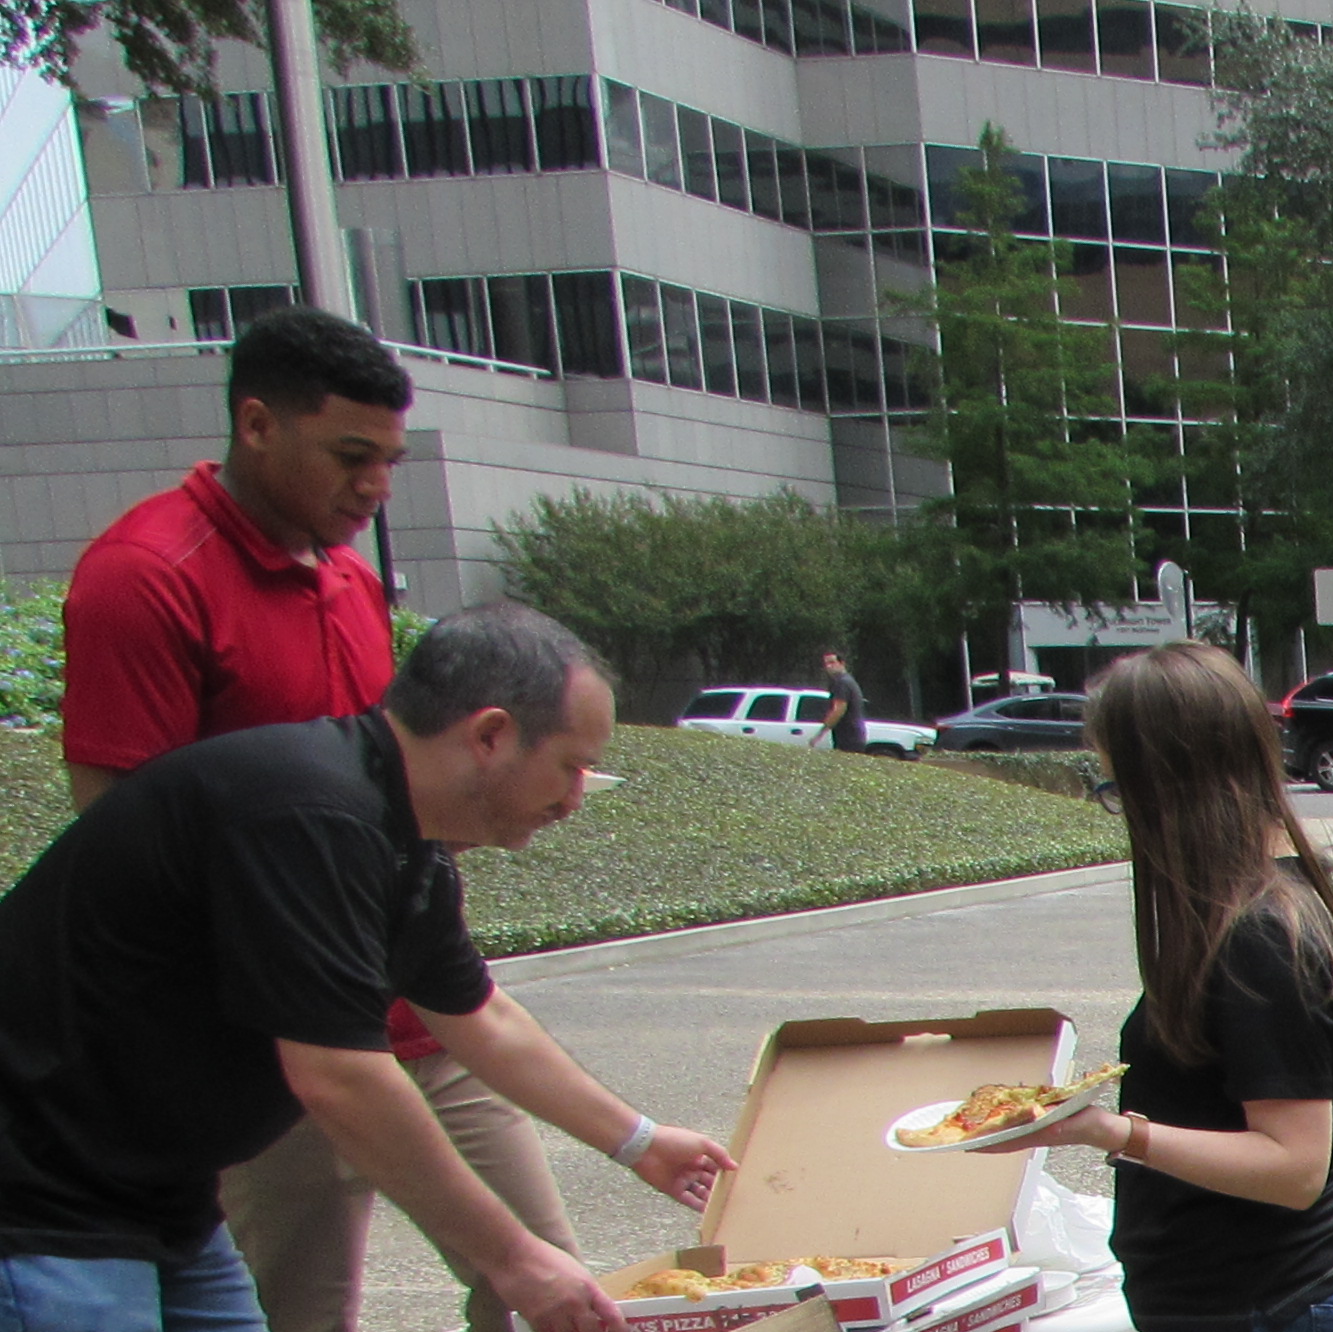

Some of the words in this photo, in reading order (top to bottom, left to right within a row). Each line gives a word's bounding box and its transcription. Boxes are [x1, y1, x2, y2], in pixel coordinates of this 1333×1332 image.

[907, 1266, 941, 1293] LASAGNA
[946, 1246, 990, 1275] SANDWICHES
[662, 1315, 717, 1332] PIZZA
[967, 1294, 1022, 1327] SANDWICHES
